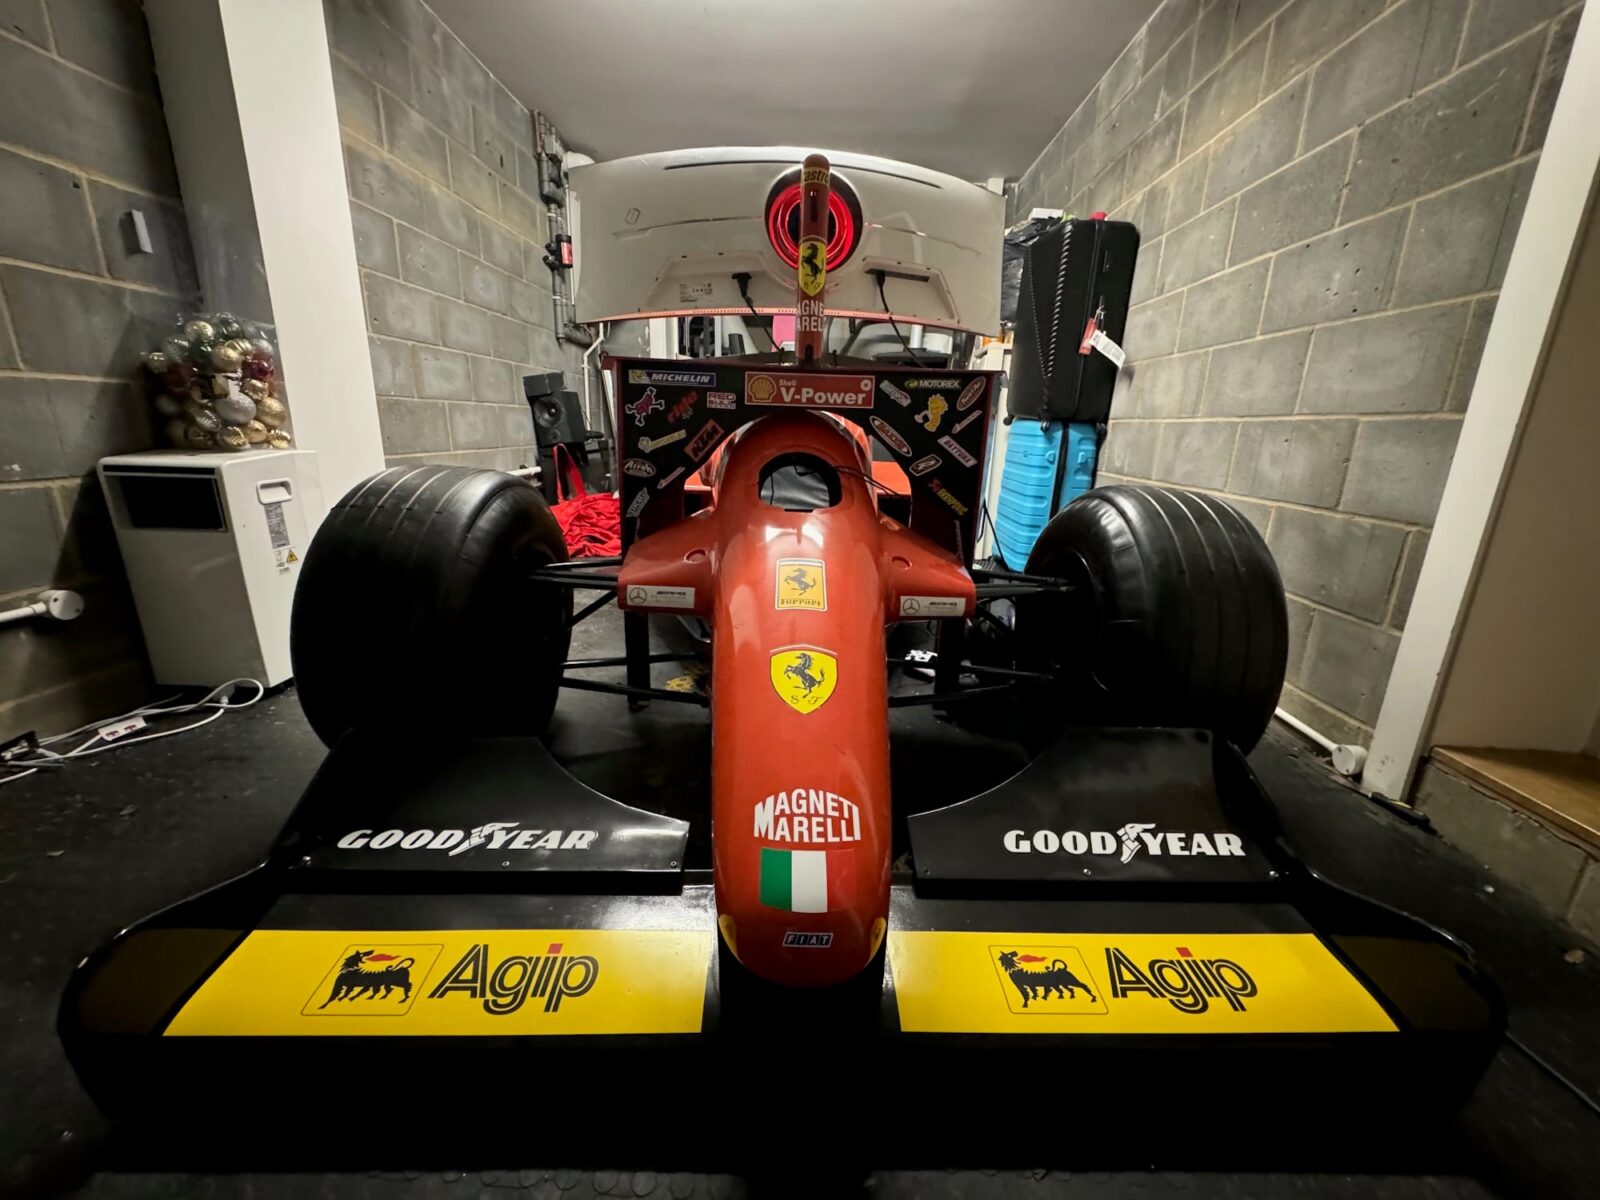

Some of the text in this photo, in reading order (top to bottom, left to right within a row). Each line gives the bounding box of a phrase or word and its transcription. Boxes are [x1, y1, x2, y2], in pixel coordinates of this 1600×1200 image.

[651, 372, 710, 384] MICHELIN
[779, 379, 797, 387] Shell
[919, 379, 960, 389] MOTOREX
[780, 387, 867, 405] V-Power
[691, 425, 720, 458] KTM
[780, 598, 822, 607] Ferrari
[790, 695, 800, 705] S
[754, 789, 860, 822] MAGNETI
[754, 812, 861, 843] MARELLI
[787, 934, 829, 945] FIAT
[427, 943, 599, 1015] Agip
[1104, 946, 1258, 1014] Agip
